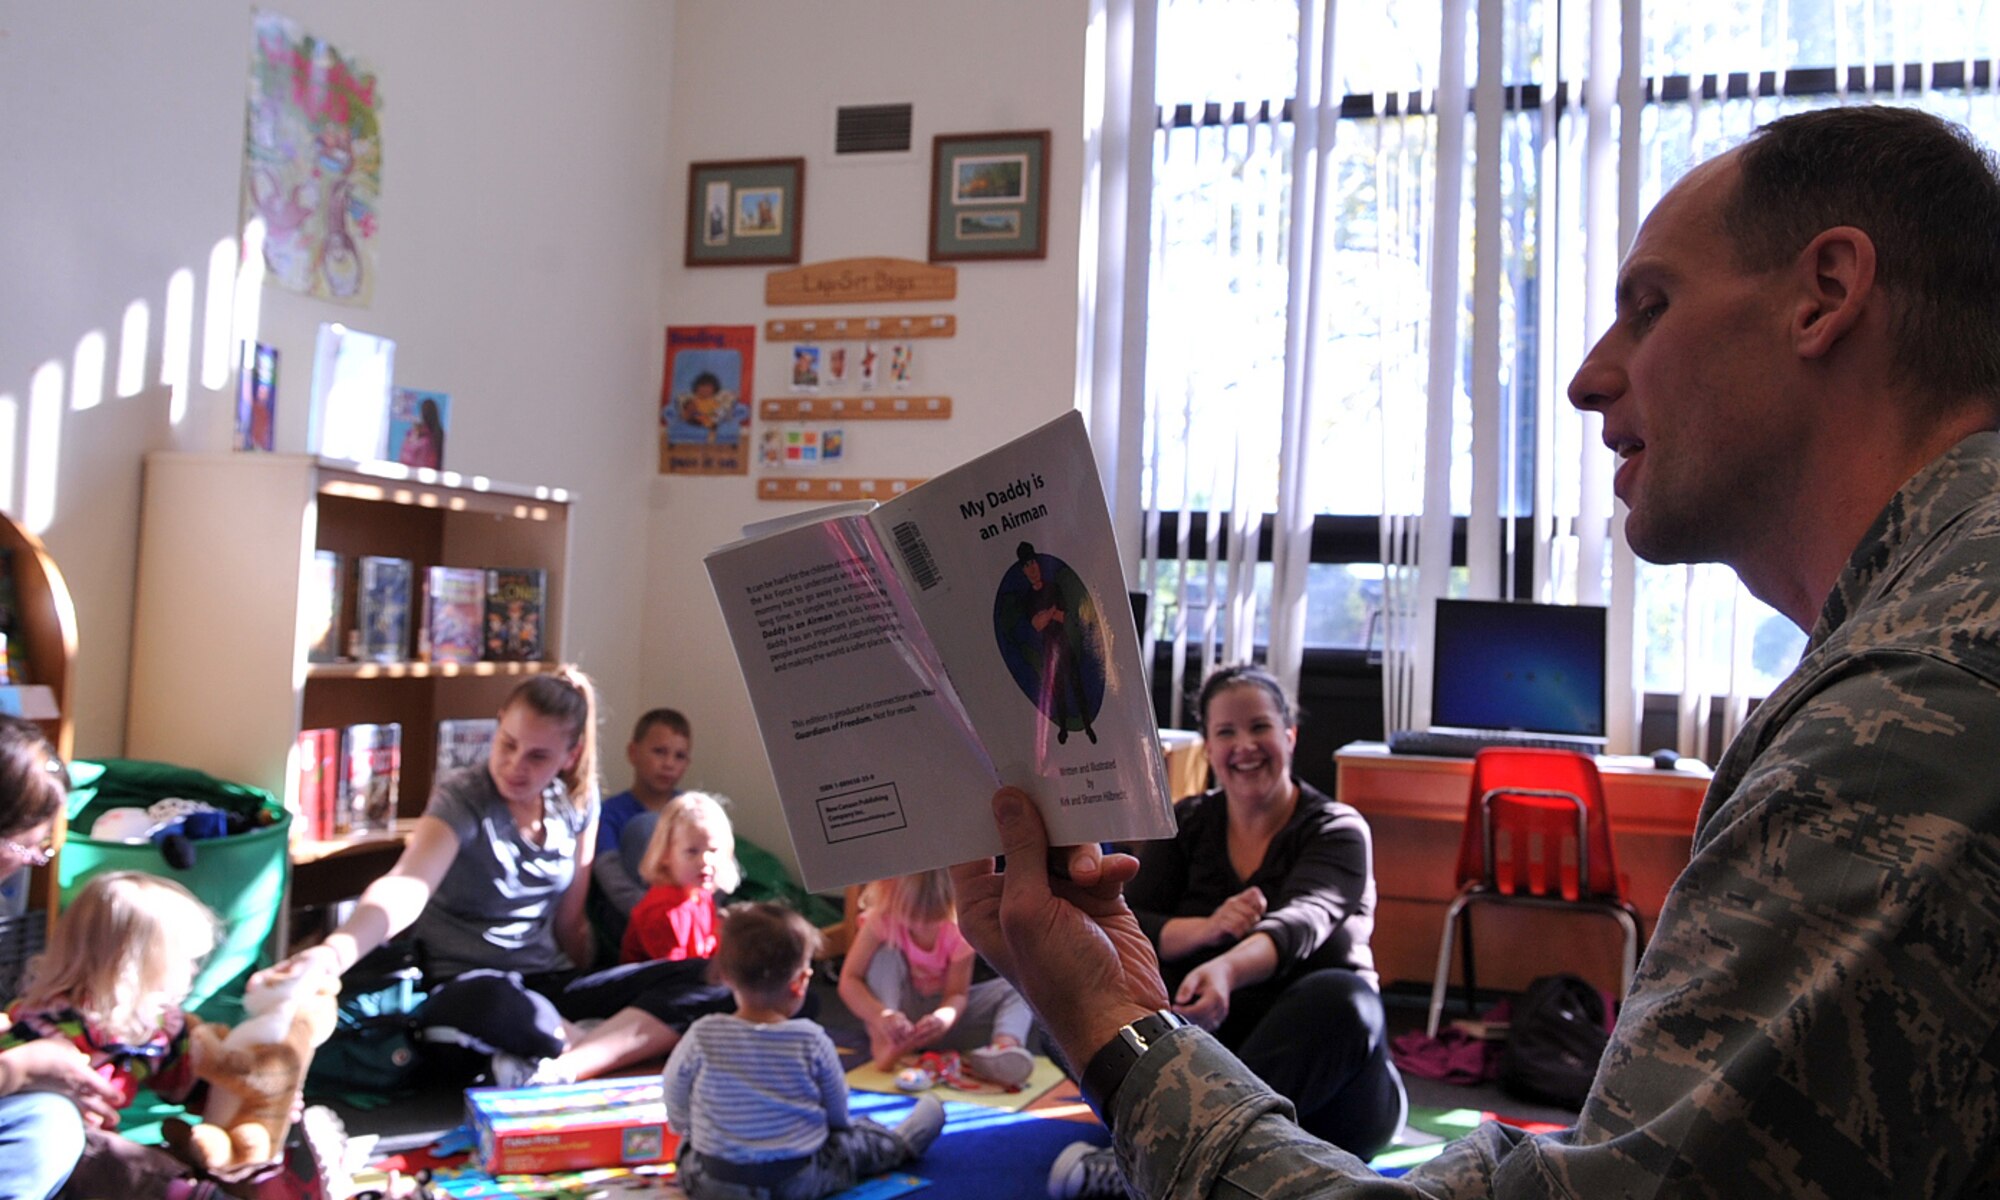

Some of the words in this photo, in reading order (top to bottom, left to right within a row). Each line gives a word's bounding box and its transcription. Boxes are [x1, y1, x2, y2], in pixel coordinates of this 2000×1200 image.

[960, 500, 985, 520] My
[985, 478, 1031, 508] Daddy
[1030, 472, 1045, 490] is
[979, 523, 1000, 541] an
[1001, 503, 1049, 532] Airman
[750, 597, 762, 605] the
[774, 588, 793, 597] Force
[804, 574, 839, 589] understand
[752, 584, 764, 592] can
[773, 576, 789, 585] hard
[754, 604, 782, 616] mommy
[805, 594, 814, 603] go
[816, 590, 832, 598] away
[758, 618, 774, 627] long
[803, 604, 825, 614] simple
[826, 599, 840, 607] text
[841, 595, 854, 604] and
[762, 627, 785, 639] Daddy
[807, 614, 833, 625] Airman
[848, 606, 863, 614] kids
[766, 639, 787, 650] daddy
[813, 622, 846, 636] important
[770, 650, 793, 662] people
[794, 642, 817, 654] around
[774, 663, 787, 673] and
[788, 657, 813, 668] making
[826, 647, 845, 658] world
[850, 642, 866, 651] safer
[834, 704, 864, 719] produced
[873, 695, 908, 708] connection
[794, 727, 831, 740] Guardians
[832, 722, 839, 731] of
